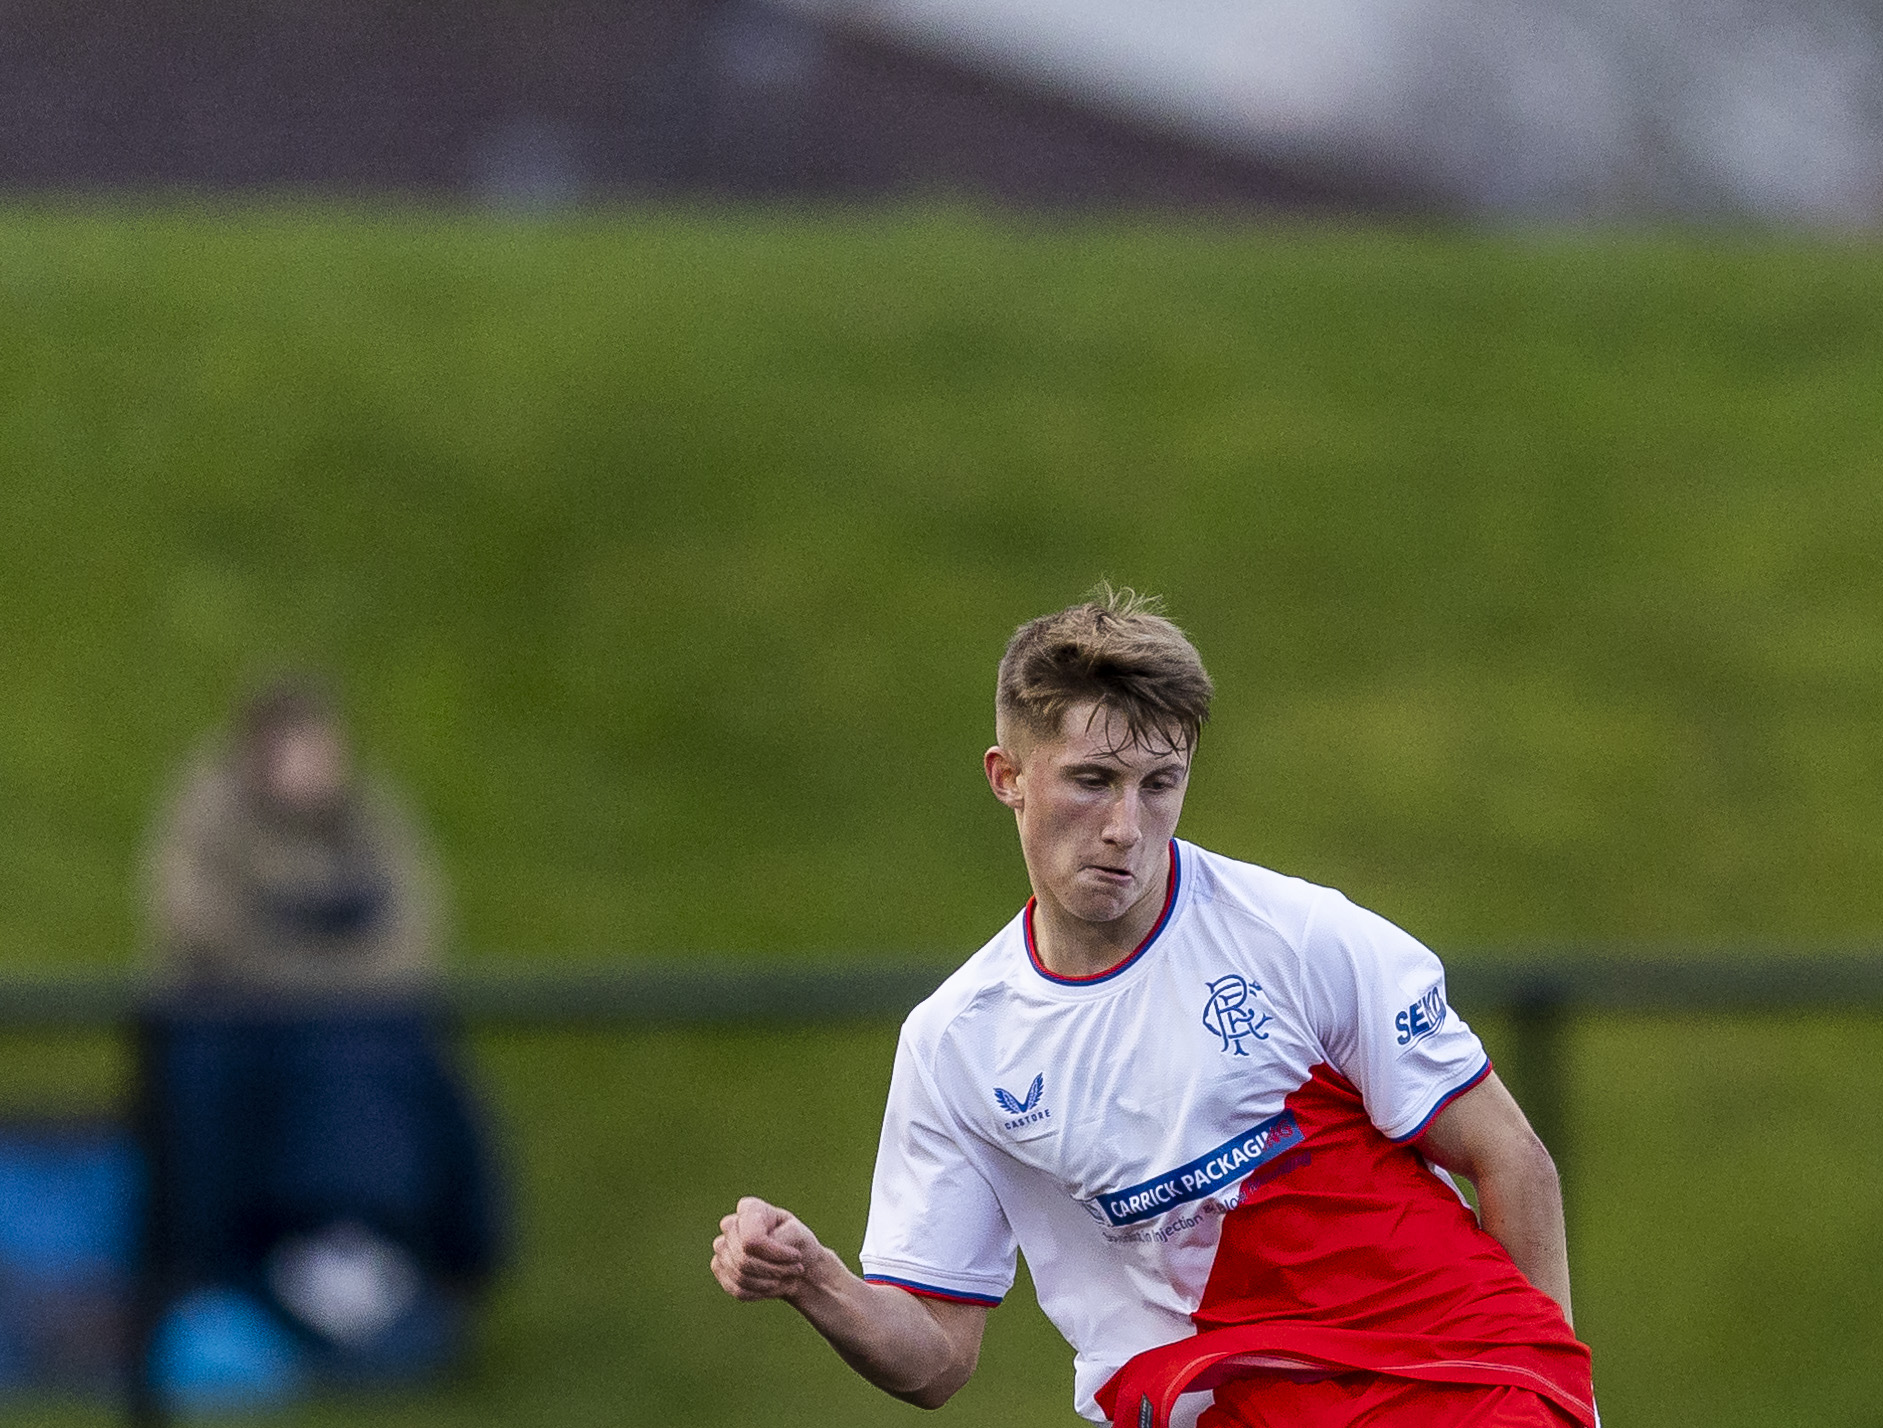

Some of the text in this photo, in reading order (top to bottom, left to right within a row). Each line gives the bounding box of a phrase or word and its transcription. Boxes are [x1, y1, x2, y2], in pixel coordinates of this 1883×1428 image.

[1004, 1109, 1051, 1130] CASTORE
[1110, 1180, 1183, 1219] CARRICK
[1180, 1119, 1293, 1192] PACKAGING
[1151, 1214, 1203, 1243] Injection
